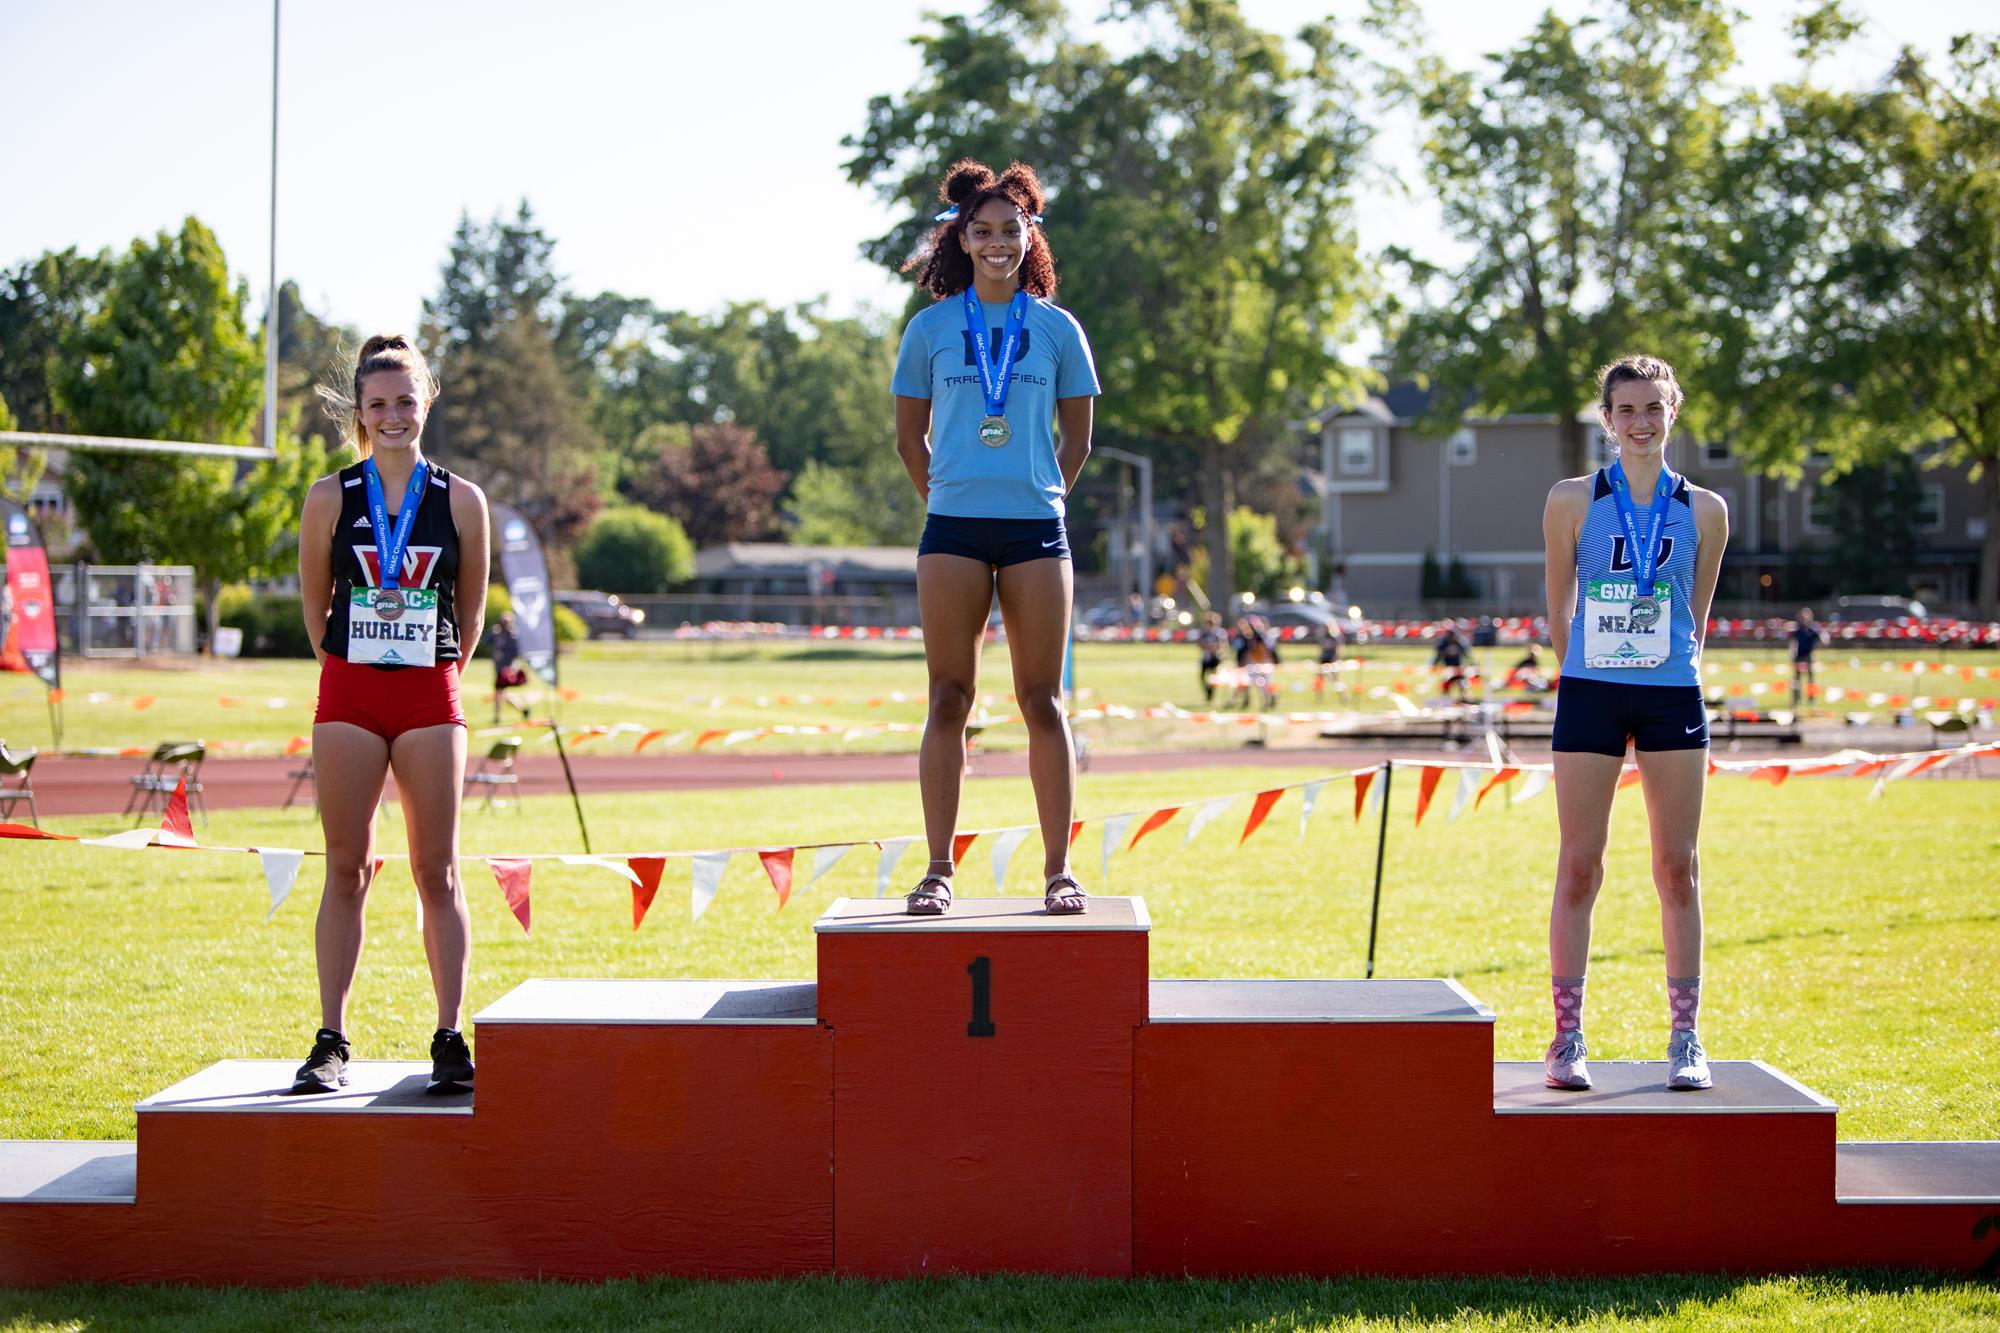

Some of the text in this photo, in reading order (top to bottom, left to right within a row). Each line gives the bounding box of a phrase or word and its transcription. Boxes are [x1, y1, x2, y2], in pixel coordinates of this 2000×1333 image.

[976, 333, 984, 350] GNAC
[994, 335, 1015, 400] GNAC Championships
[944, 375, 981, 388] TRAC
[375, 505, 384, 523] GNAC
[1625, 512, 1634, 530] GNAC
[388, 509, 412, 574] GNAC Championships
[1643, 513, 1661, 579] GNAC Championships
[1600, 583, 1637, 600] GNA
[377, 602, 399, 610] gnac
[351, 621, 434, 642] HURLEY
[967, 956, 996, 1037] 1
